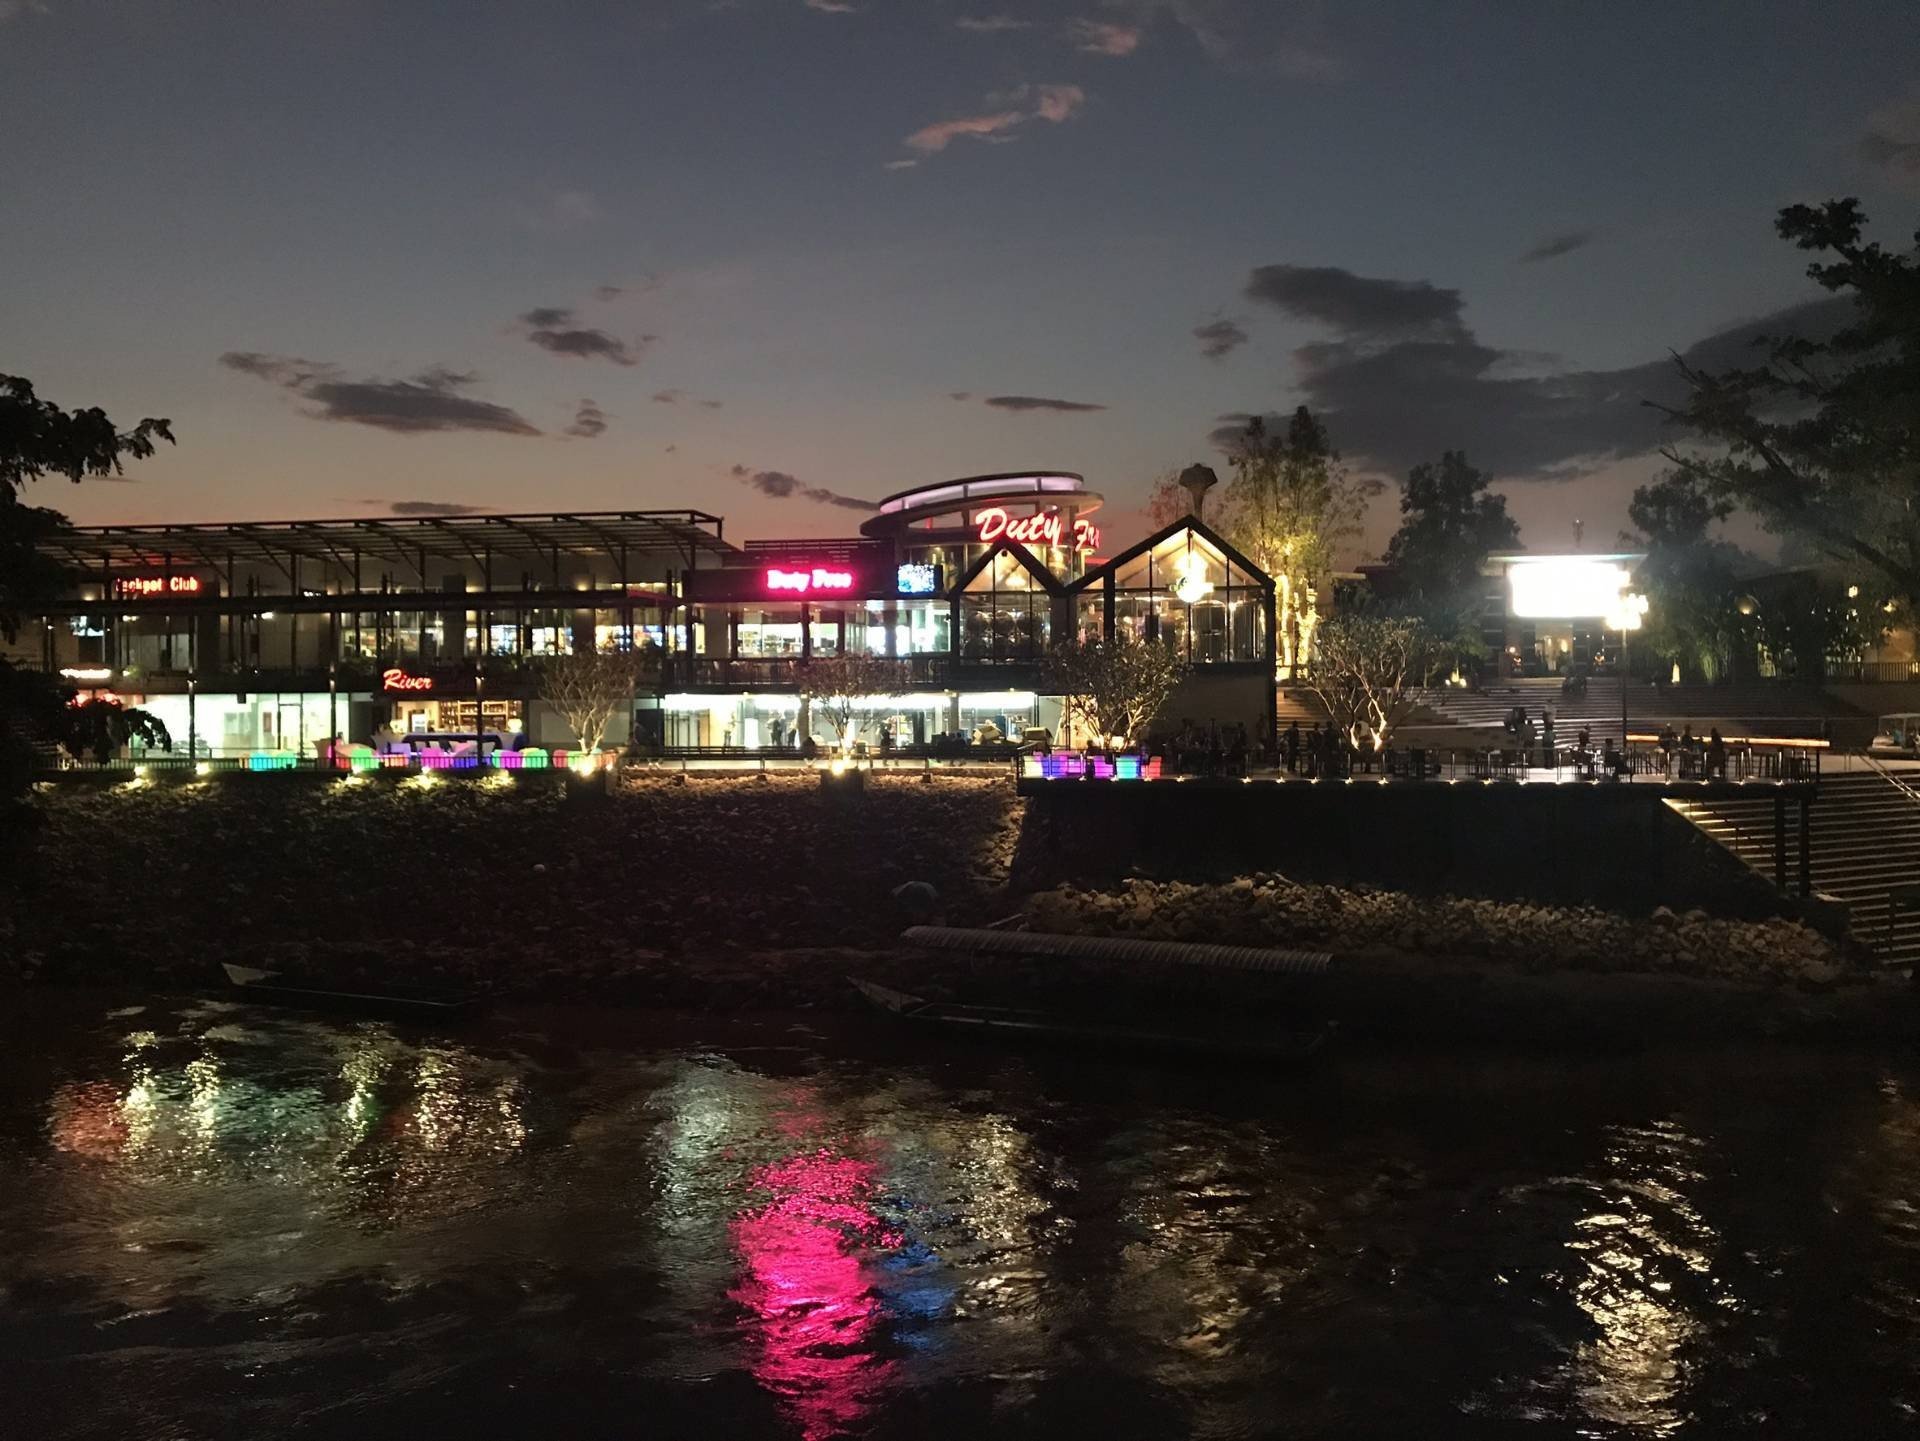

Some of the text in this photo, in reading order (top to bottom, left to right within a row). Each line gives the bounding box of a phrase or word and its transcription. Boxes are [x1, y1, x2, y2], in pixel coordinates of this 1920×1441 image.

[975, 507, 1062, 550] Duty
[169, 576, 199, 592] Club
[383, 668, 433, 690] River
